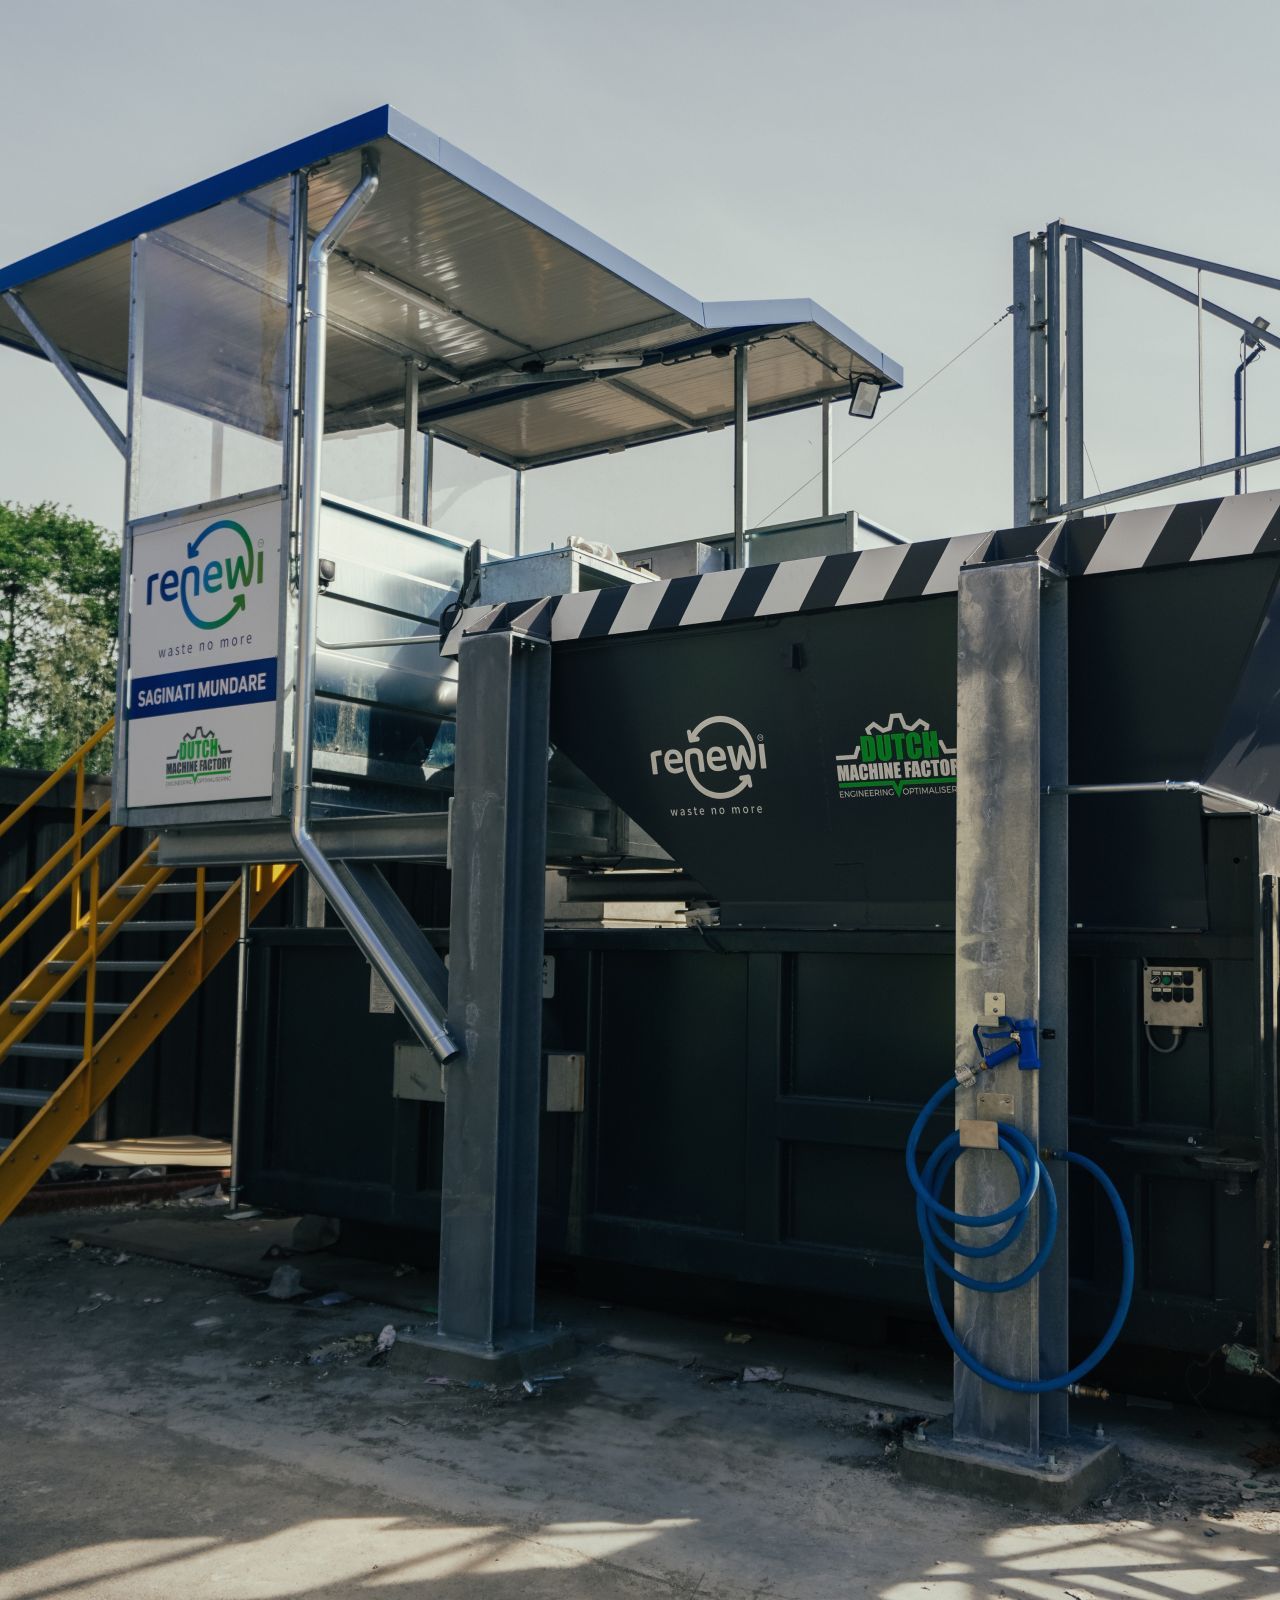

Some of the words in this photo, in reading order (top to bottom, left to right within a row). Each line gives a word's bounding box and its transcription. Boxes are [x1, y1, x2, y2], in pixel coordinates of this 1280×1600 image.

[158, 643, 193, 659] waste
[199, 640, 214, 652] no
[220, 634, 253, 648] more
[137, 683, 195, 707] SAGINATI
[198, 672, 267, 699] MUNDARE
[179, 738, 218, 761] DUTCH
[860, 730, 940, 762] DUTCH
[165, 760, 198, 775] MACHINE
[199, 757, 232, 772] FACTORY
[837, 762, 902, 782] MACHINE
[839, 788, 895, 799] ENGINEERING
[670, 806, 705, 817] waste
[711, 806, 725, 815] no
[731, 805, 763, 815] more
